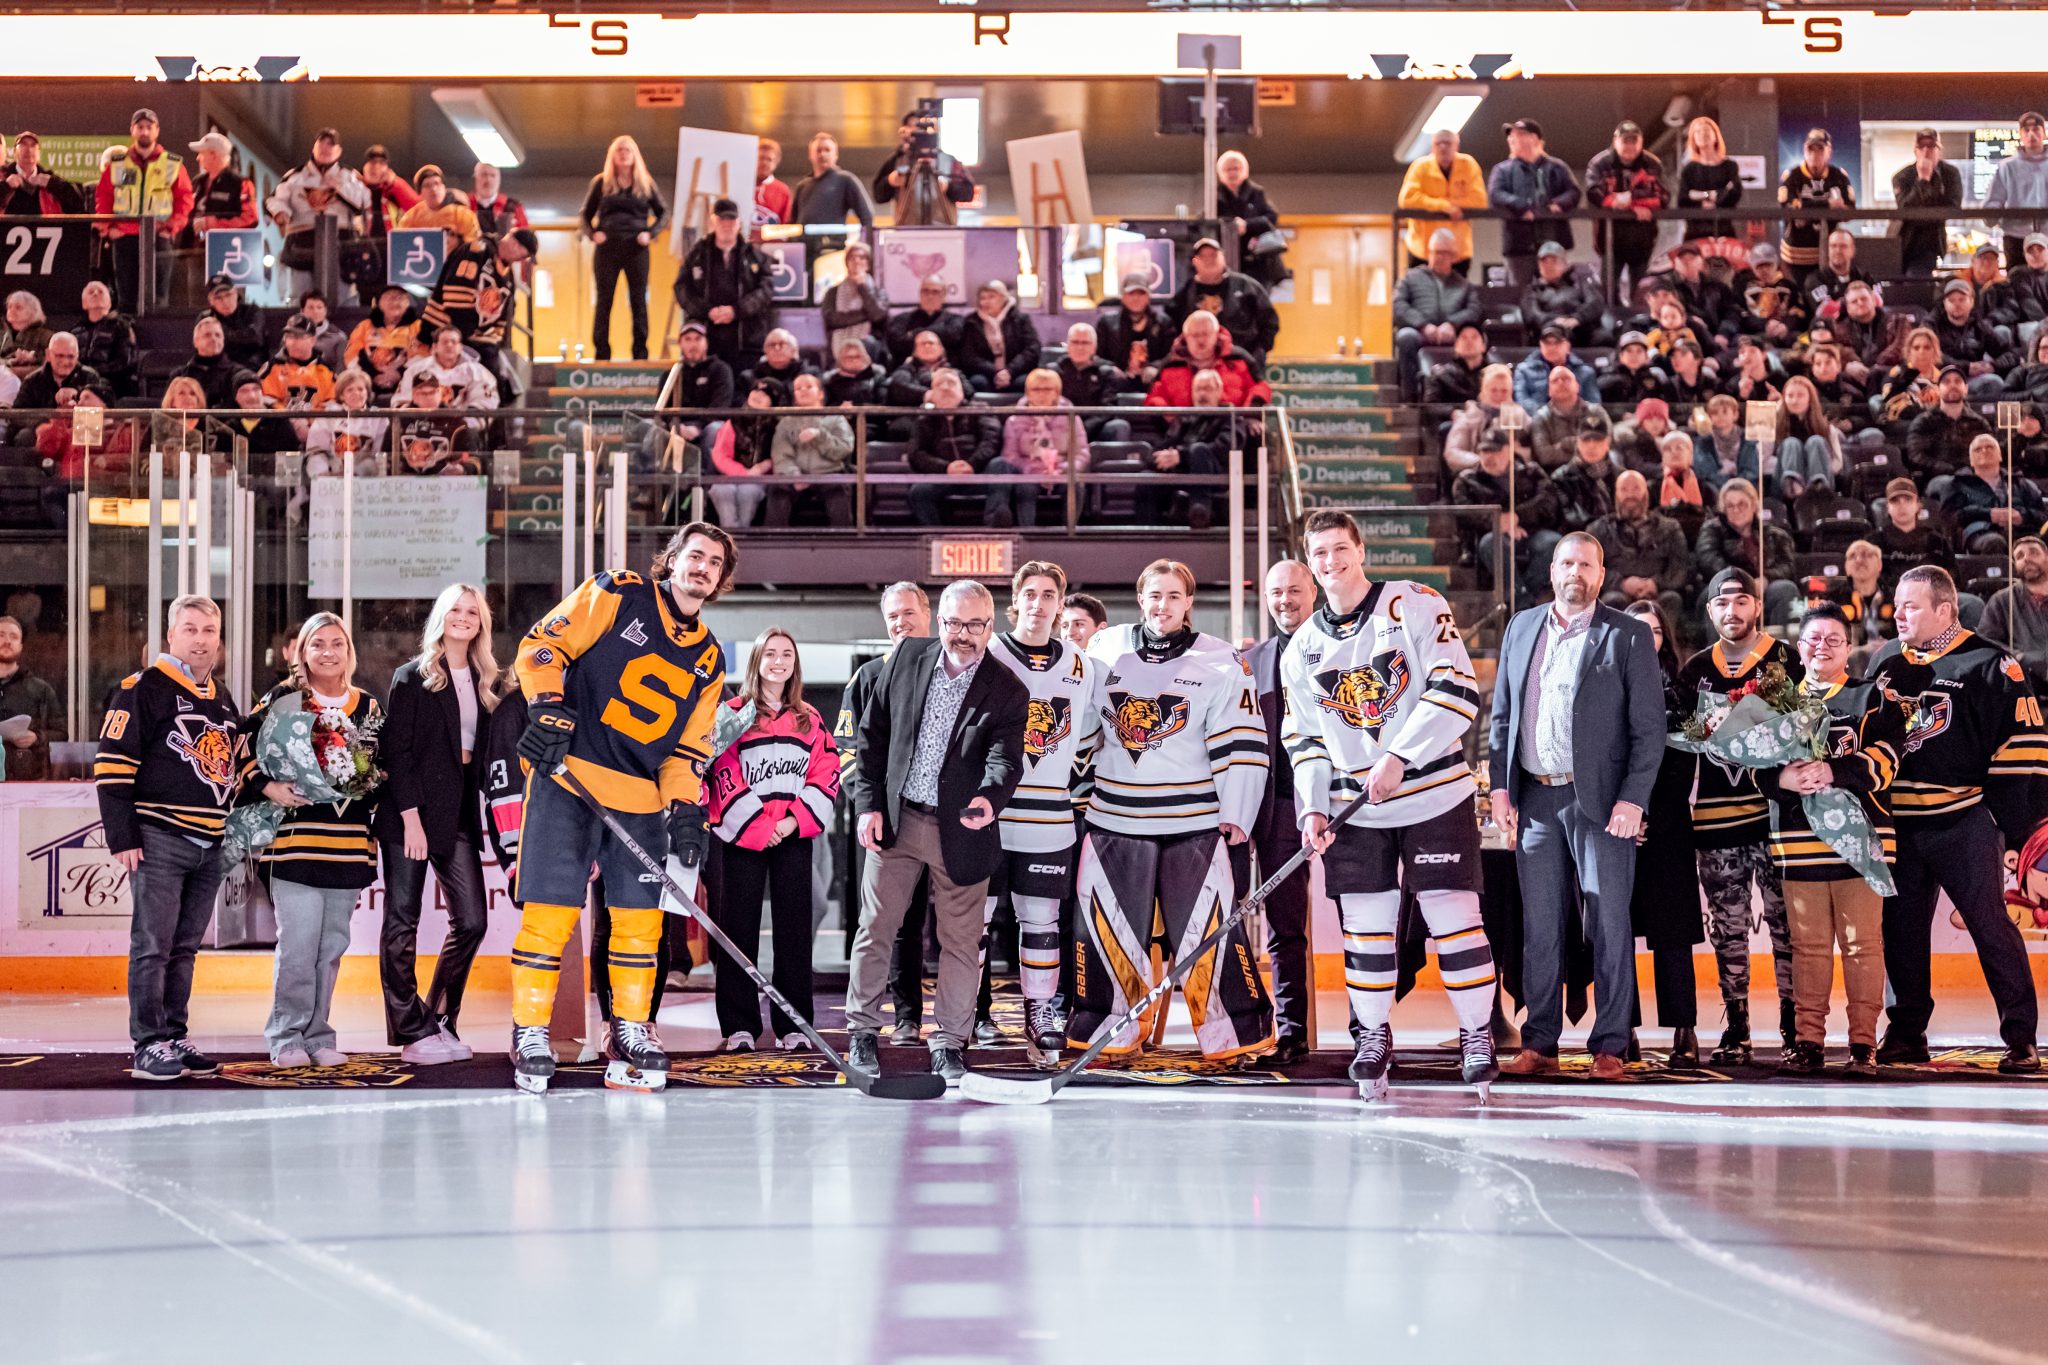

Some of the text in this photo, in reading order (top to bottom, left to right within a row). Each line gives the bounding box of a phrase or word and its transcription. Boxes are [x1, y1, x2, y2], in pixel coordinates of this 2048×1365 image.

[4, 226, 63, 275] 27
[592, 373, 660, 388] Desjardins
[1288, 369, 1358, 384] Desjardins
[1299, 418, 1371, 434] Desjardins
[1316, 469, 1391, 484] Desjardins
[1357, 520, 1411, 535] sjardins
[942, 543, 1004, 573] SORTIE
[1365, 550, 1417, 565] jardins
[1378, 626, 1403, 638] CCM
[695, 643, 718, 675] A
[1147, 642, 1171, 650] CCM
[1071, 652, 1084, 679] A
[1173, 678, 1203, 687] CCM
[1935, 679, 1964, 689] CCM
[600, 652, 696, 745] S
[2015, 697, 2044, 727] 40
[833, 709, 853, 737] 23
[490, 759, 508, 791] 3
[714, 767, 737, 802] 23
[626, 839, 677, 892] RIBCOR
[1028, 863, 1067, 875] CCM
[1414, 853, 1461, 864] CCM
[638, 873, 661, 883] CC
[1228, 874, 1282, 927] RIBCOR
[1076, 941, 1086, 998] BAUER
[1234, 943, 1259, 999] BAUER
[745, 966, 807, 1026] CCM
[1110, 975, 1171, 1038] CCM
